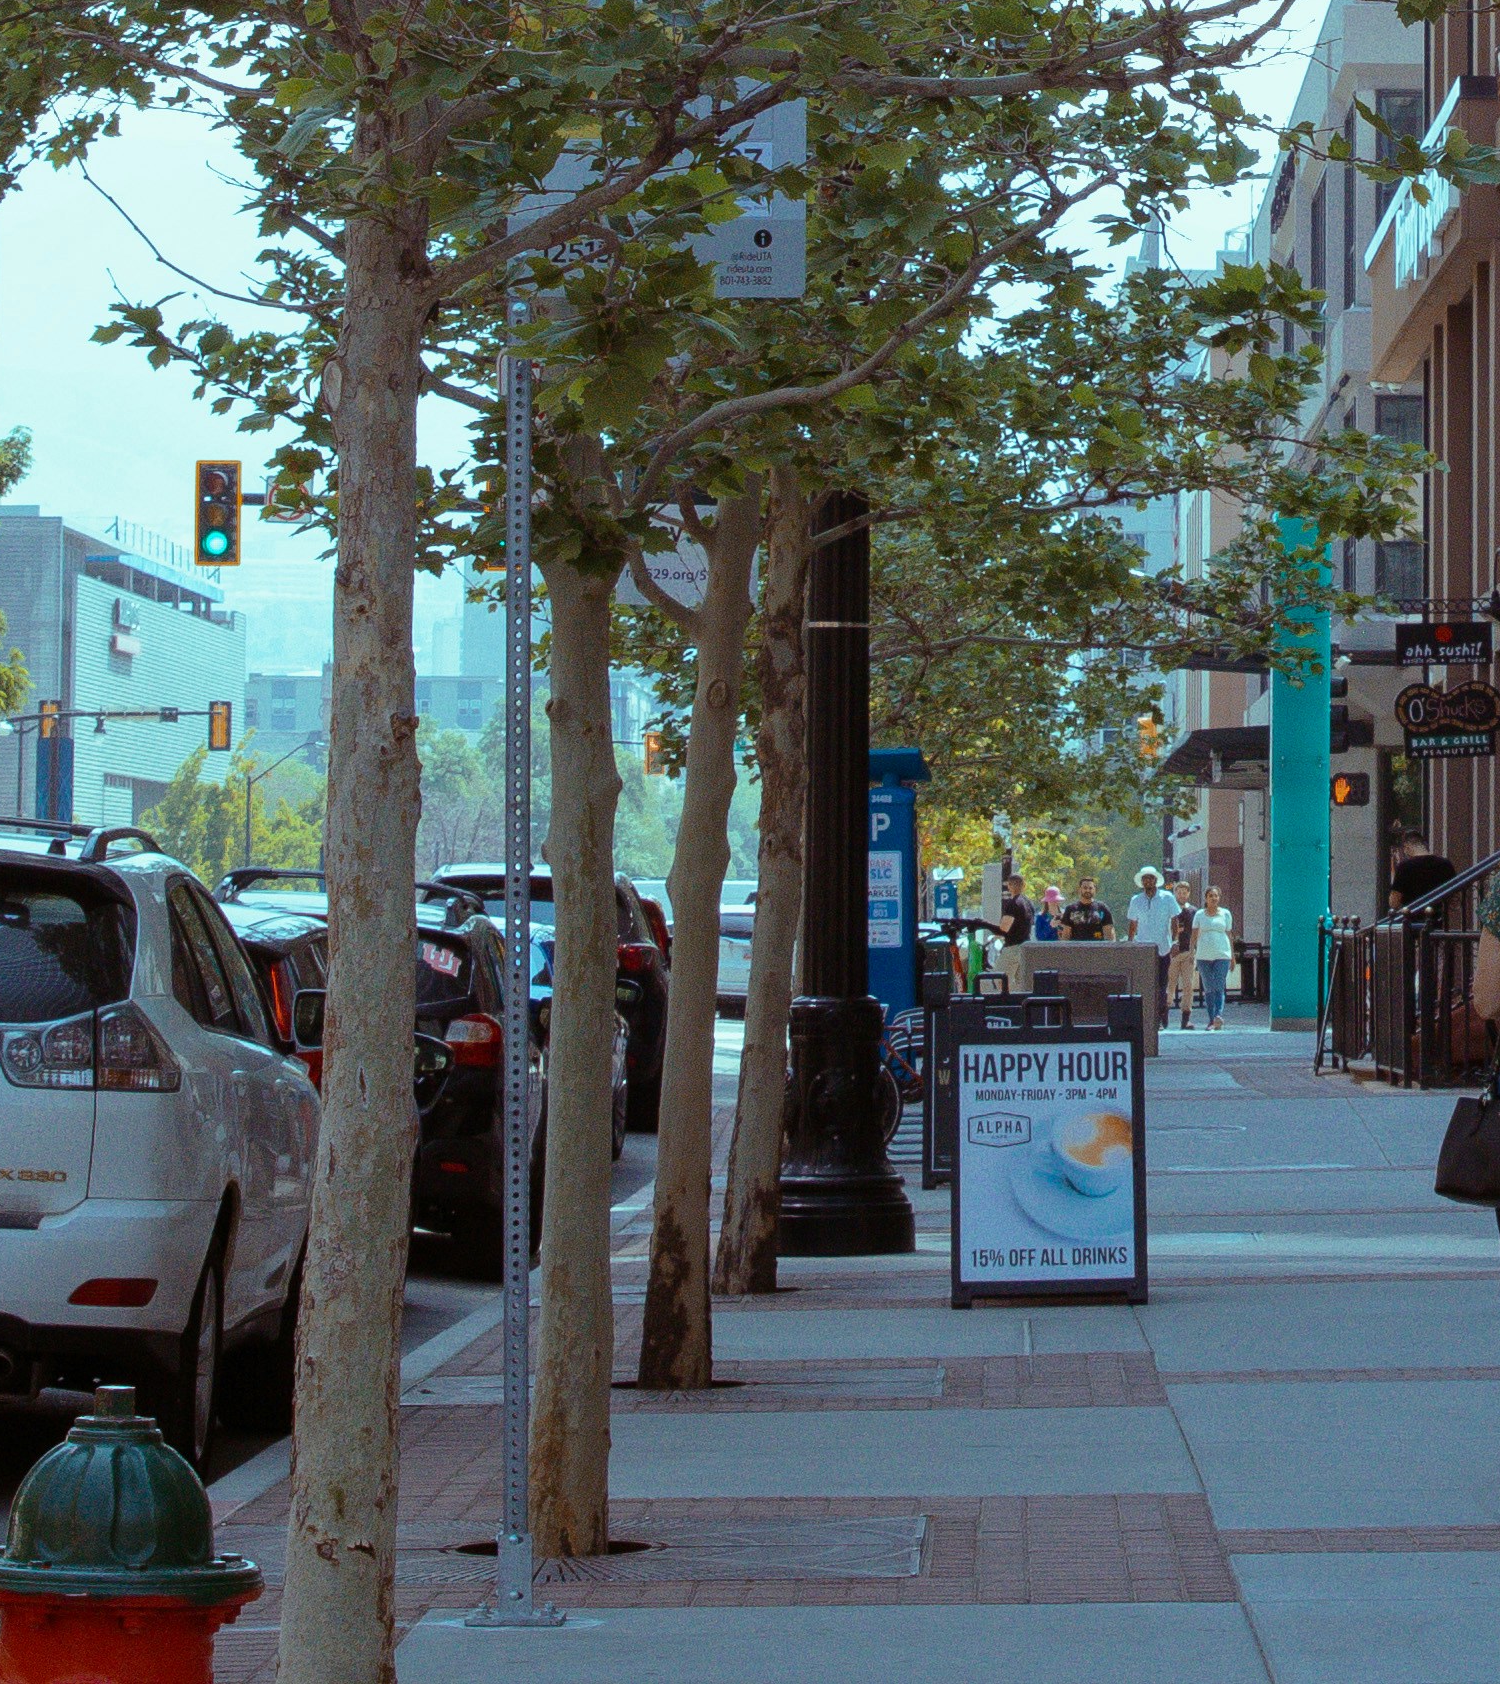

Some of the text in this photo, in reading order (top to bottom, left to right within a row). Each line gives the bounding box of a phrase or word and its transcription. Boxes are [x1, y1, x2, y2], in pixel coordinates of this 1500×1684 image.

[726, 264, 773, 274] rideuta.com
[1405, 641, 1483, 657] ahh sushi!
[1411, 737, 1436, 748] BAR
[1453, 734, 1488, 745] GRILL
[1422, 747, 1466, 757] PEANUT
[871, 812, 891, 842] P
[870, 868, 892, 879] SLC
[940, 892, 950, 905] P
[963, 1051, 1128, 1083] HAPPY HOUR
[975, 1088, 1056, 1102] MONDAY-FRIDAY
[1065, 1088, 1087, 1100] 3PM
[1095, 1087, 1118, 1100] 4PM
[976, 1120, 1023, 1134] ALPHA
[971, 1246, 1128, 1267] 15% OFF ALL DRINKS
